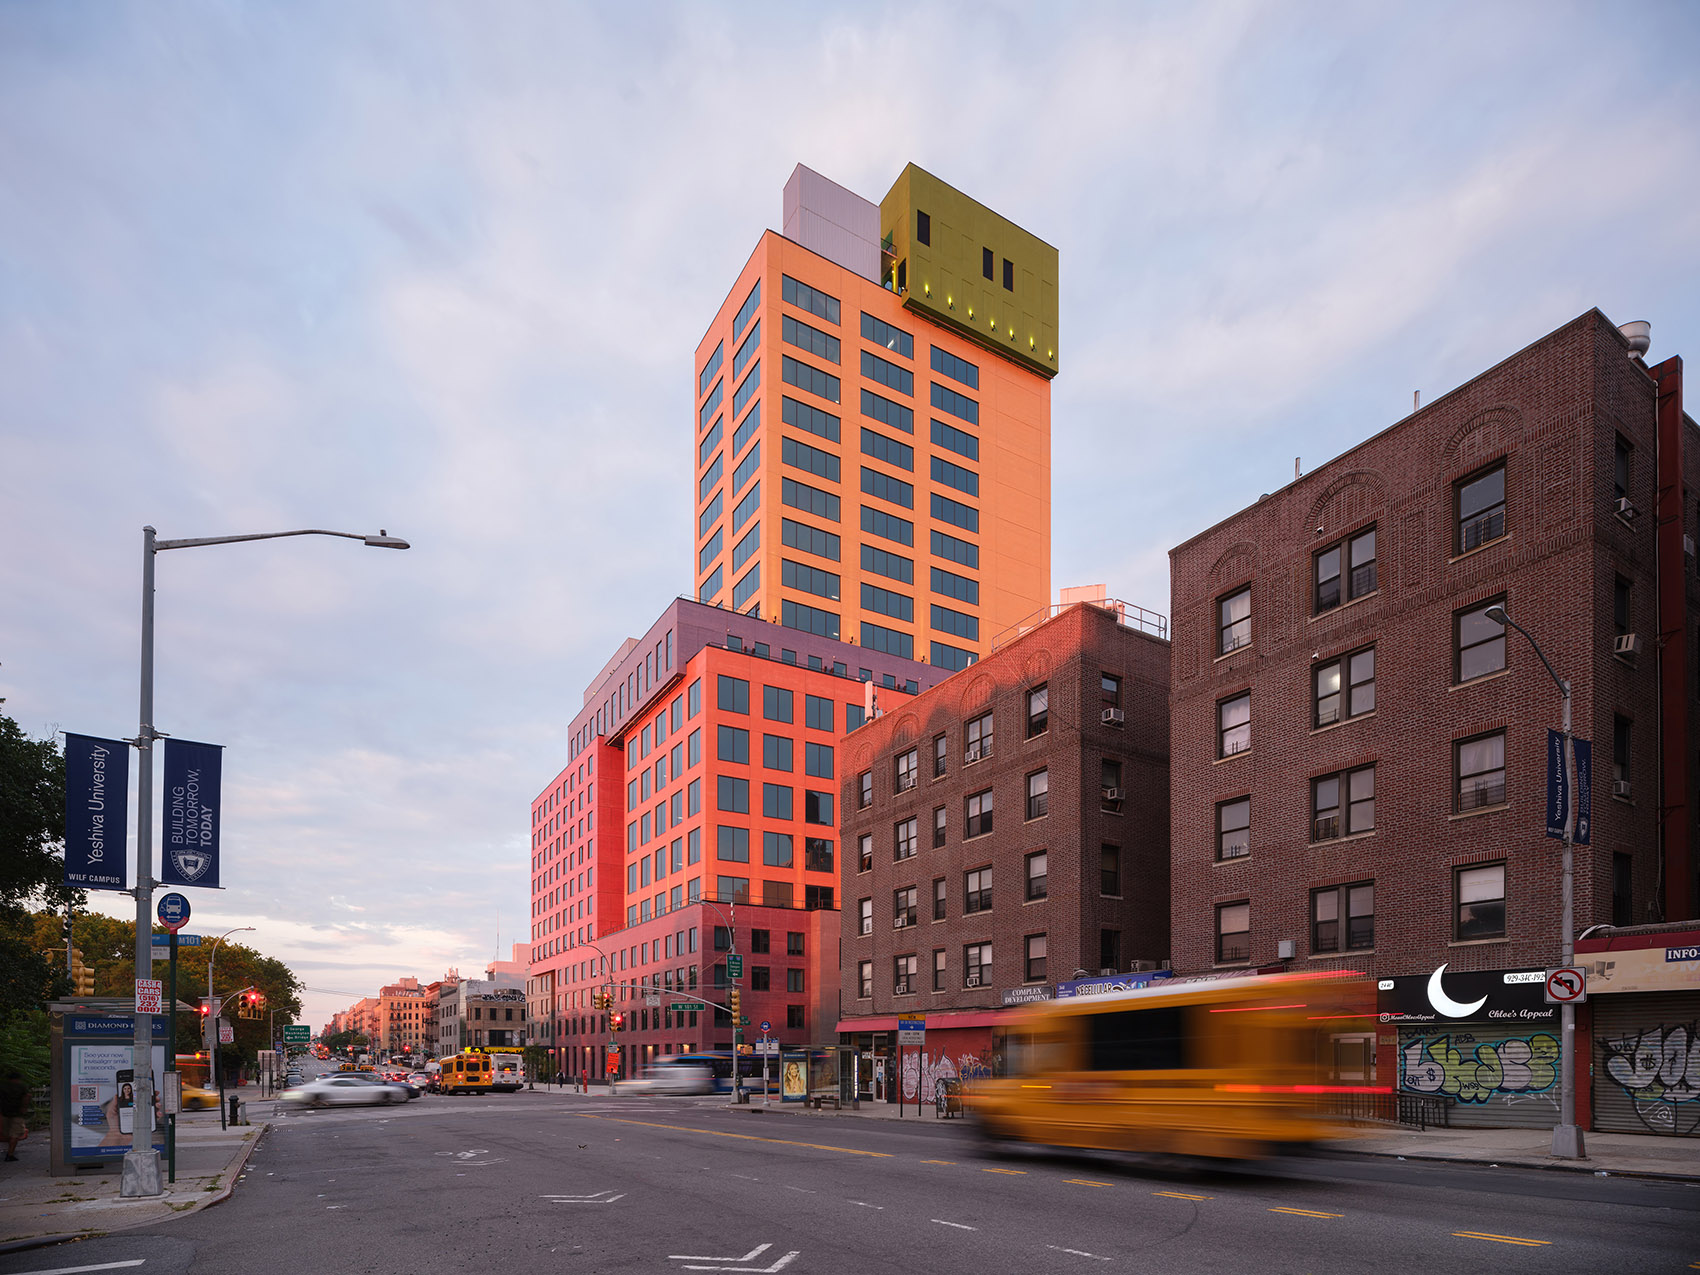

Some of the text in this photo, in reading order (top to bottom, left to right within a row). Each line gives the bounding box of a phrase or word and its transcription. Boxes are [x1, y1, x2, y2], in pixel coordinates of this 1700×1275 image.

[1554, 736, 1563, 783] University
[87, 744, 110, 865] Yeshiva University
[1554, 785, 1563, 821] Yeshiva
[171, 786, 185, 844] BUILDING
[200, 804, 213, 847] TODAY
[68, 873, 120, 884] WILF CAMPUS
[178, 936, 200, 945] M101
[138, 987, 160, 995] CARS
[1012, 987, 1042, 996] COMPLEX
[1004, 994, 1050, 1003] DEVELOPMENT
[1488, 1008, 1554, 1020] Chloe's Appeal
[87, 1022, 129, 1030] DIAMOND
